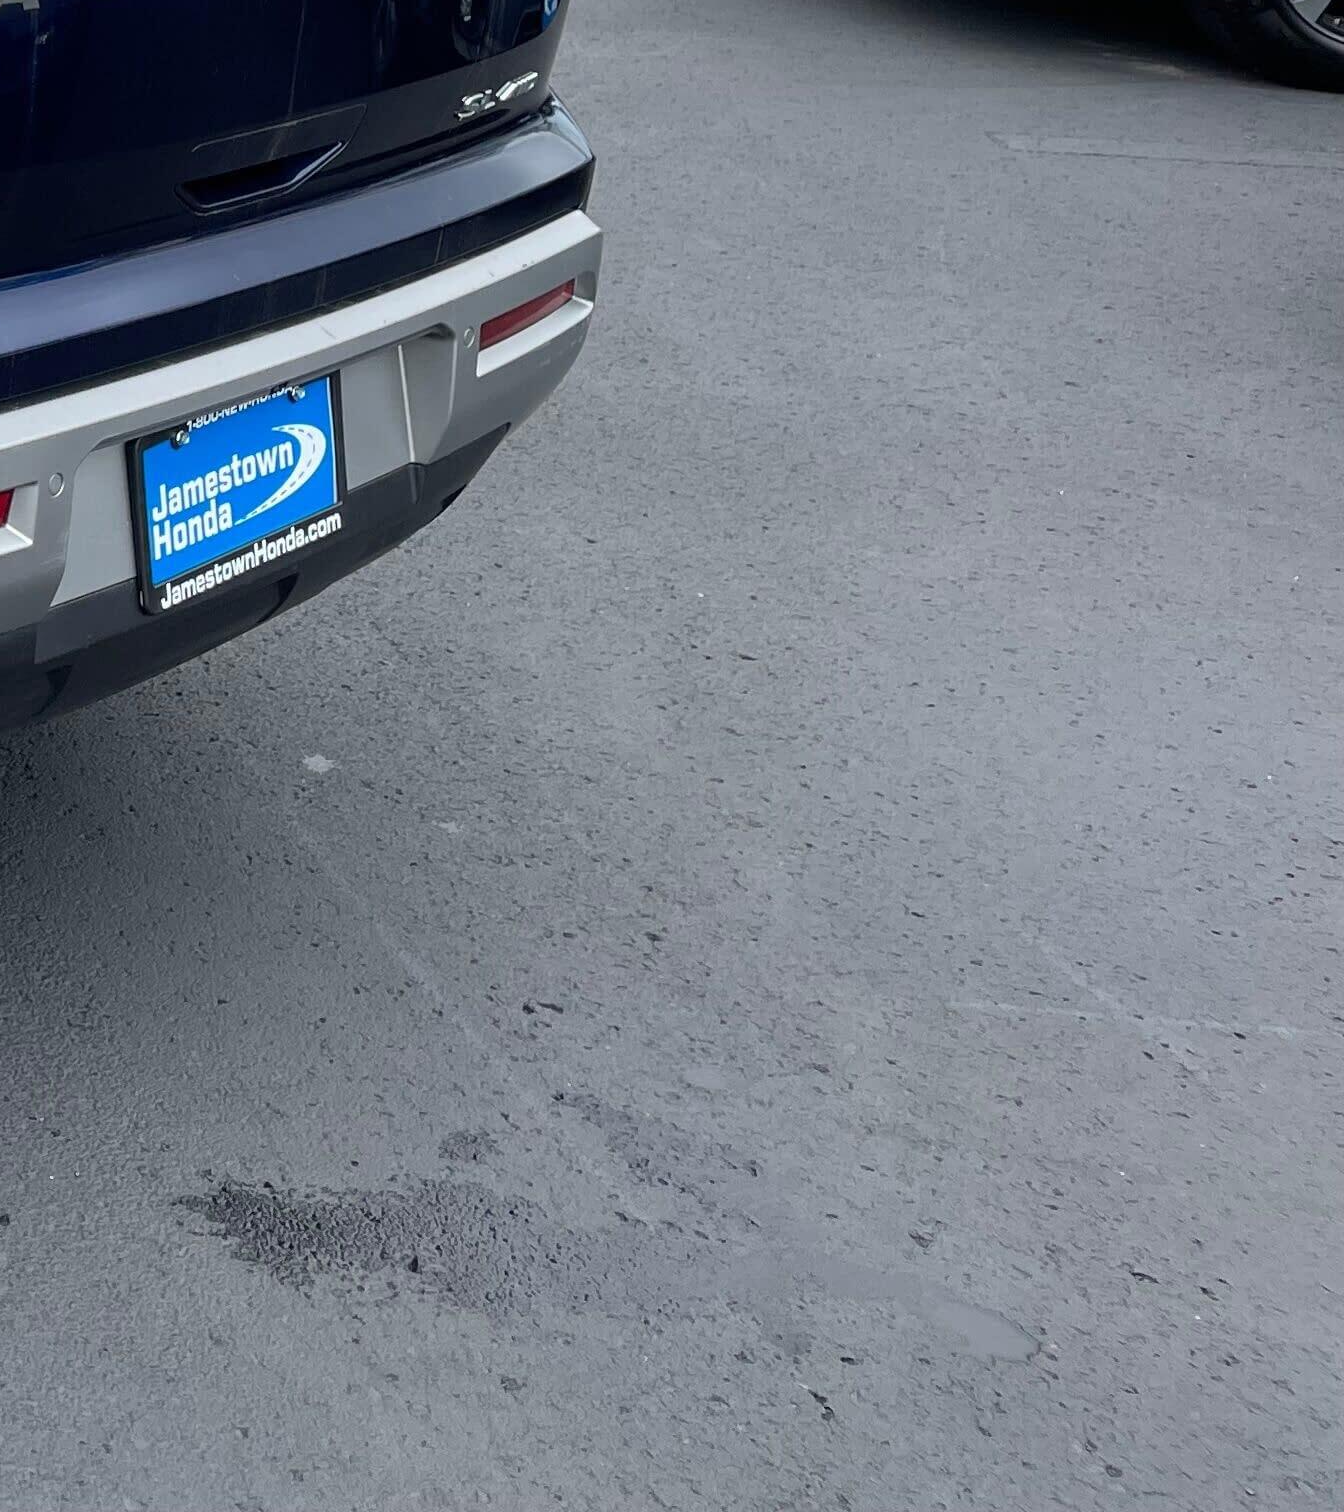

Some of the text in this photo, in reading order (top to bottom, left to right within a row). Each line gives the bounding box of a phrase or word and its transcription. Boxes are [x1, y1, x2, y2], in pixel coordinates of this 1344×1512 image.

[151, 440, 294, 522] Jamestown
[151, 498, 234, 561] Honda
[160, 512, 342, 610] JamestownHonda.com
